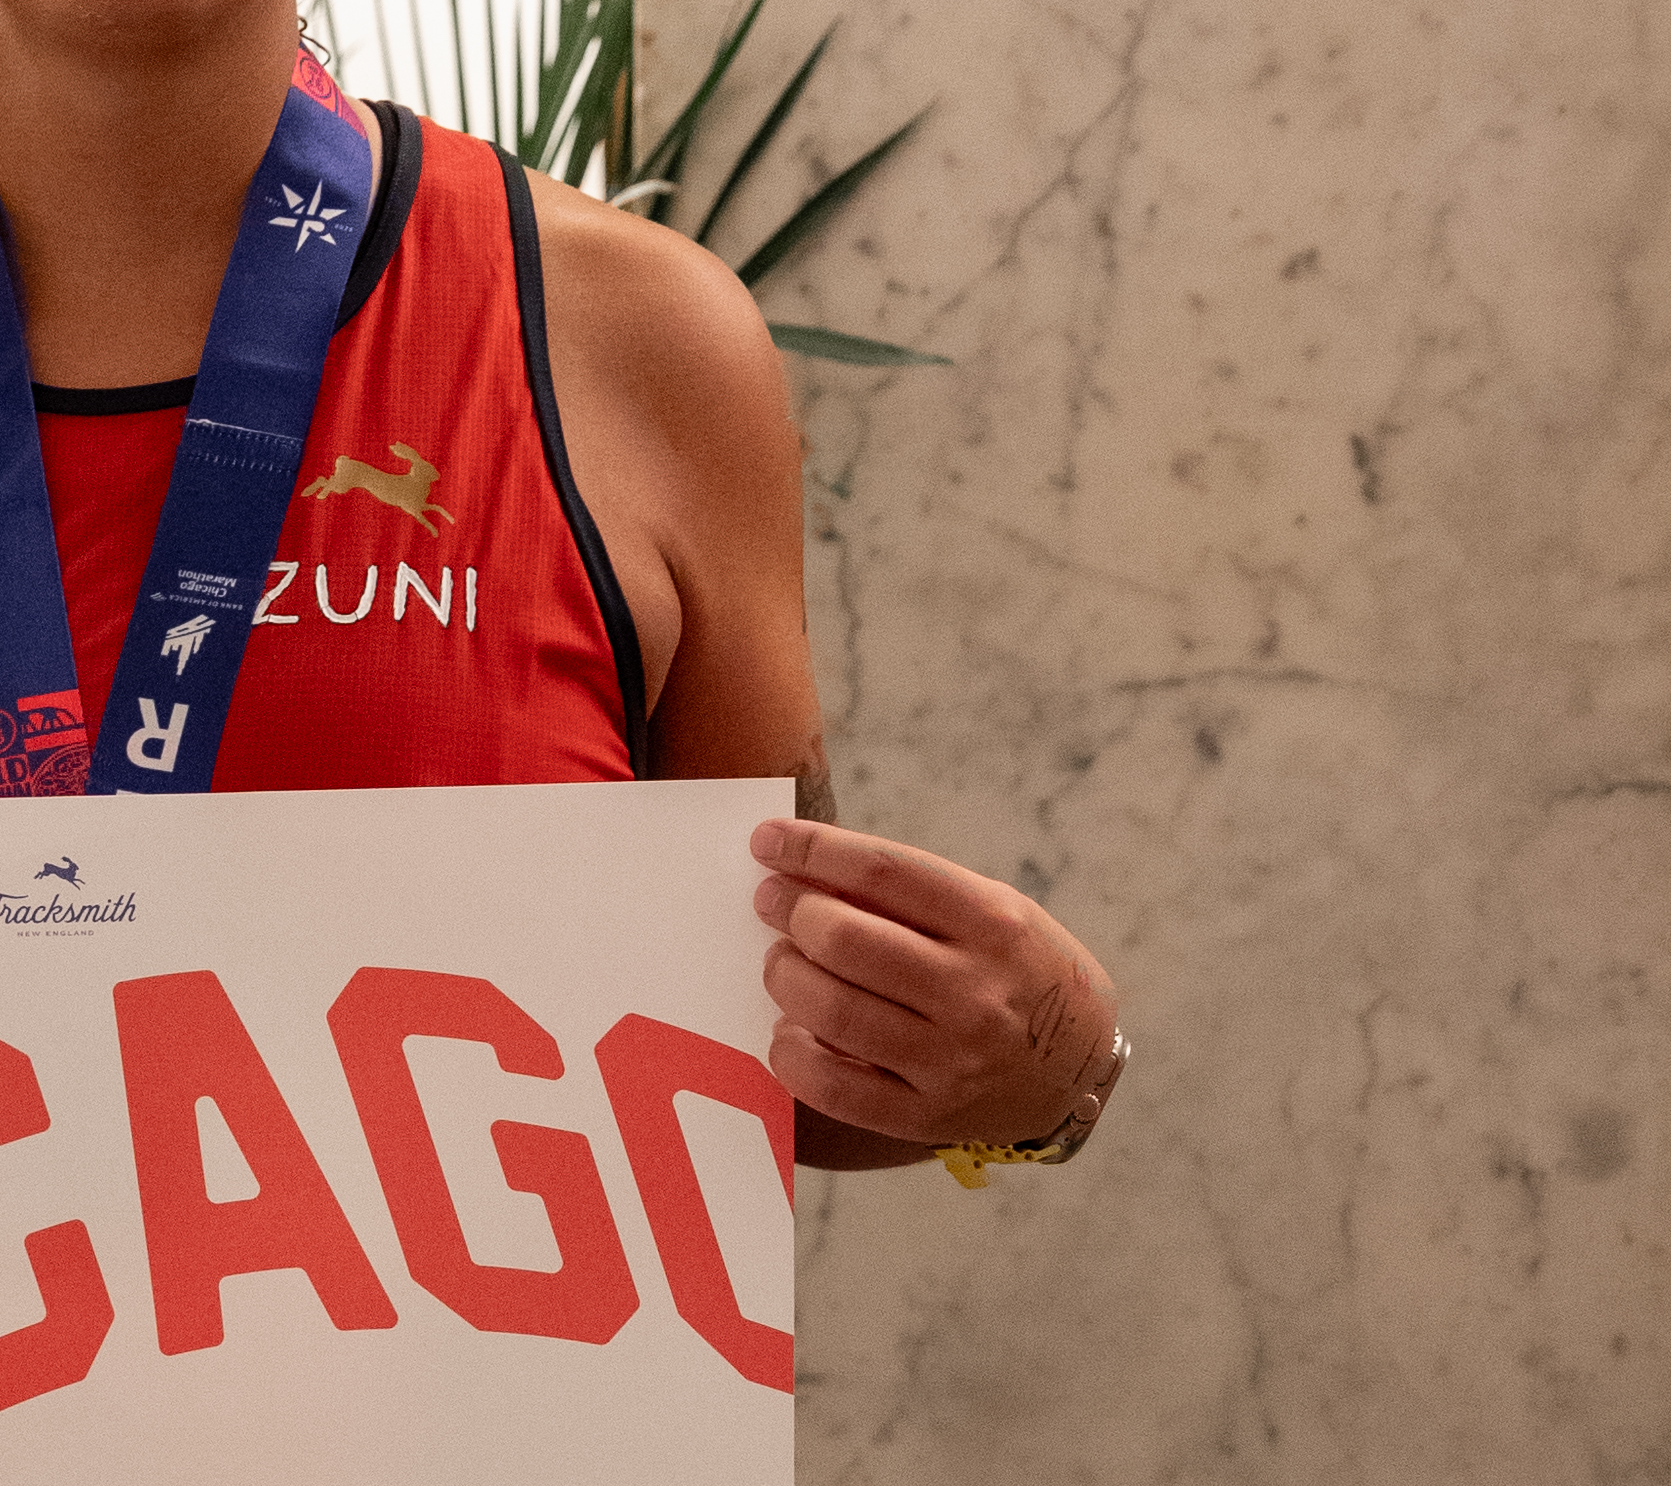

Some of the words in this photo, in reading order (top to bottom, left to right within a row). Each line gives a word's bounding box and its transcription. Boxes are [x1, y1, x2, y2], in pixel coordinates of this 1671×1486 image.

[178, 569, 237, 588] Marathon
[180, 582, 227, 597] Chicago
[251, 561, 477, 632] ZUNI
[17, 930, 41, 938] NEW
[46, 929, 95, 937] ENGLAND
